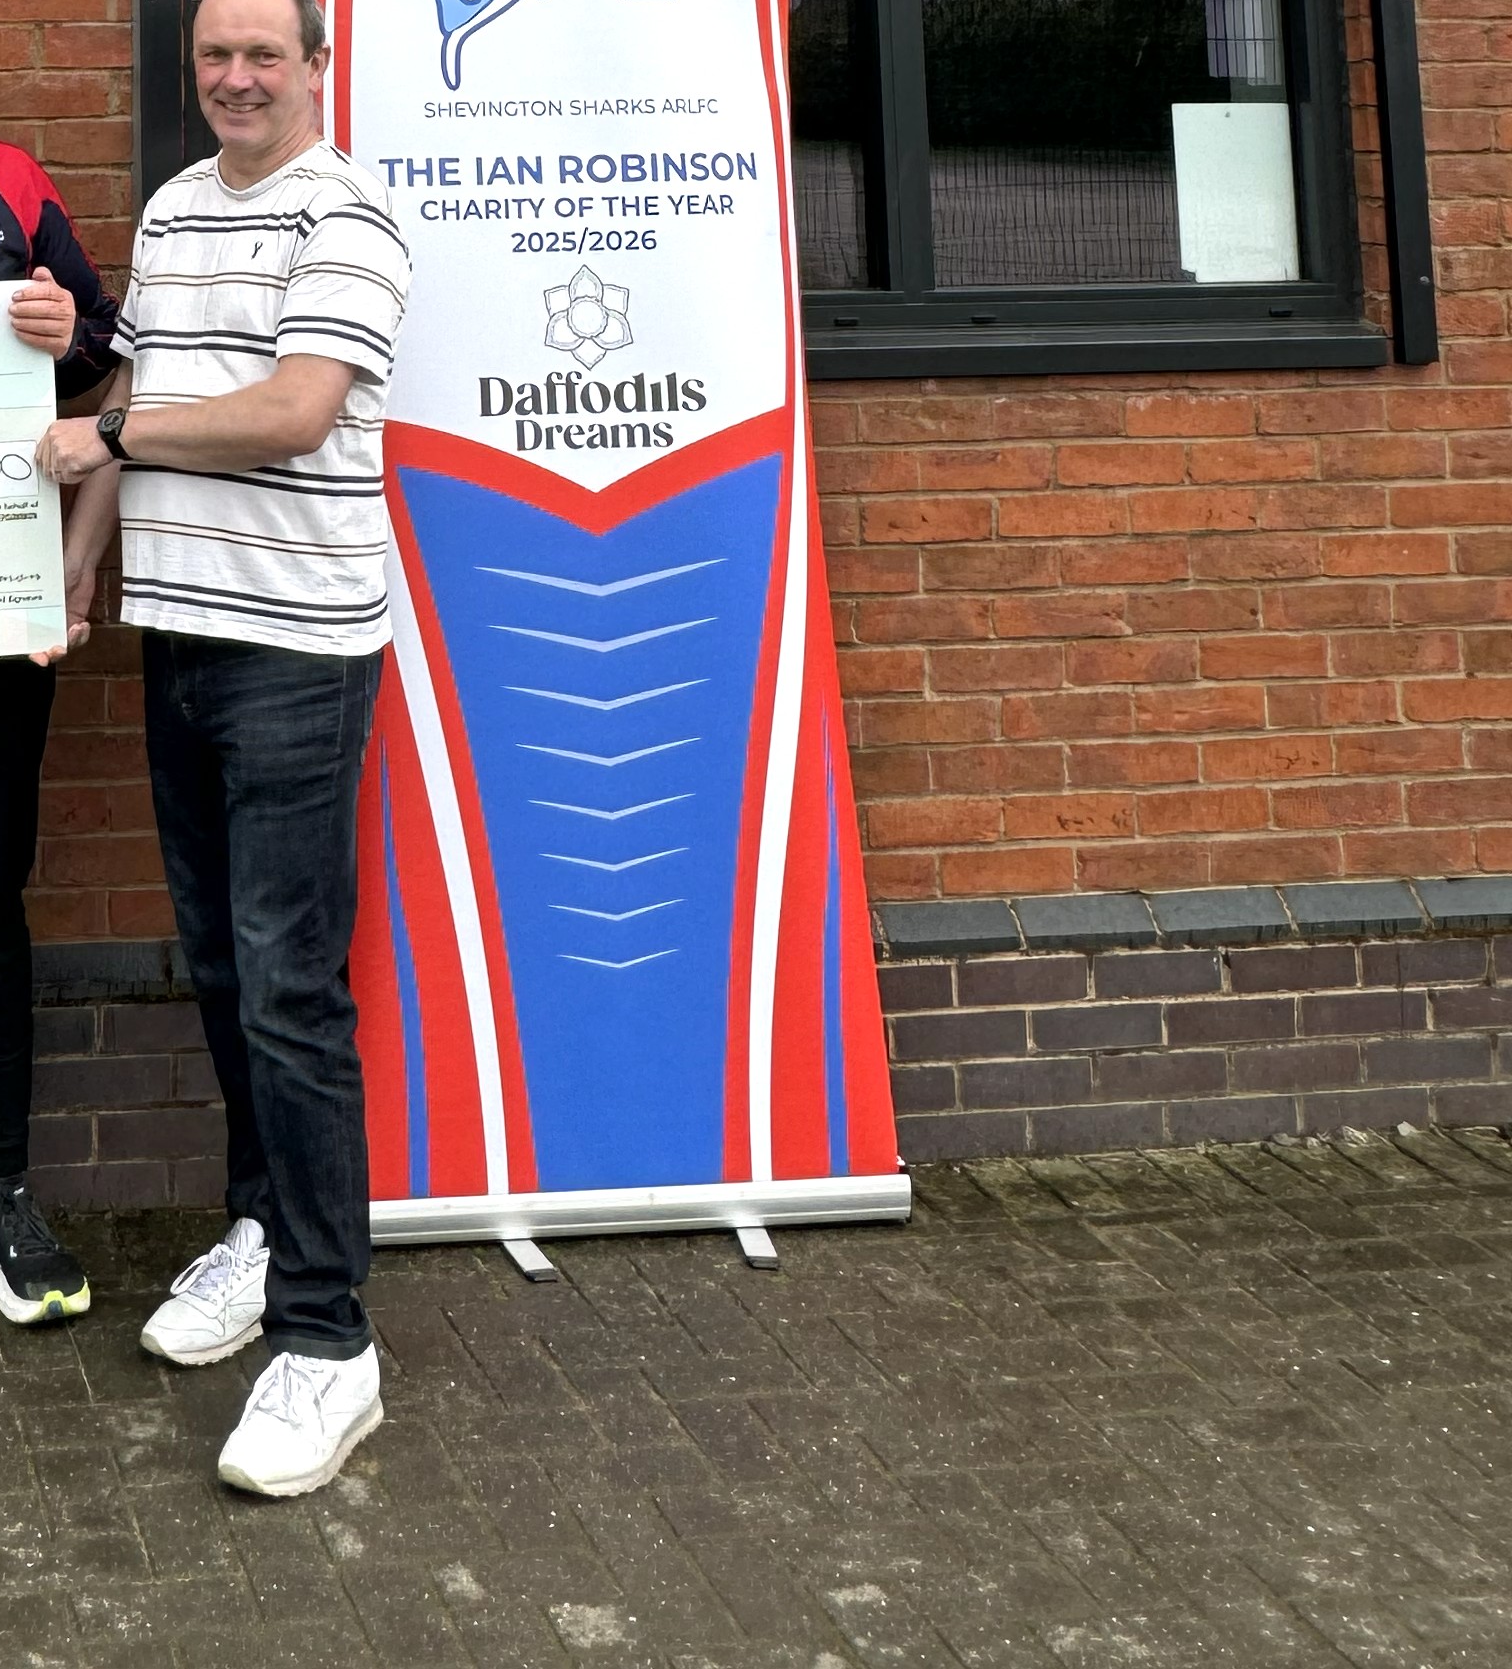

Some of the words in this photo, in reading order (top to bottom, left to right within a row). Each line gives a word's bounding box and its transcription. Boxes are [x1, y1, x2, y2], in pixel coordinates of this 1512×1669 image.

[423, 100, 563, 119] SHEVINGTON
[569, 98, 656, 116] SHARKS
[661, 98, 719, 114] ARLFC
[379, 157, 462, 188] THE
[475, 155, 543, 186] IAN
[558, 152, 757, 184] ROBINSON
[420, 197, 546, 221] CHARITY
[554, 196, 594, 218] OF
[601, 195, 660, 218] THE
[667, 194, 735, 216] YEAR
[511, 226, 657, 255] 2025/2026
[478, 370, 707, 417] Daffodils
[515, 418, 674, 452] Dreams
